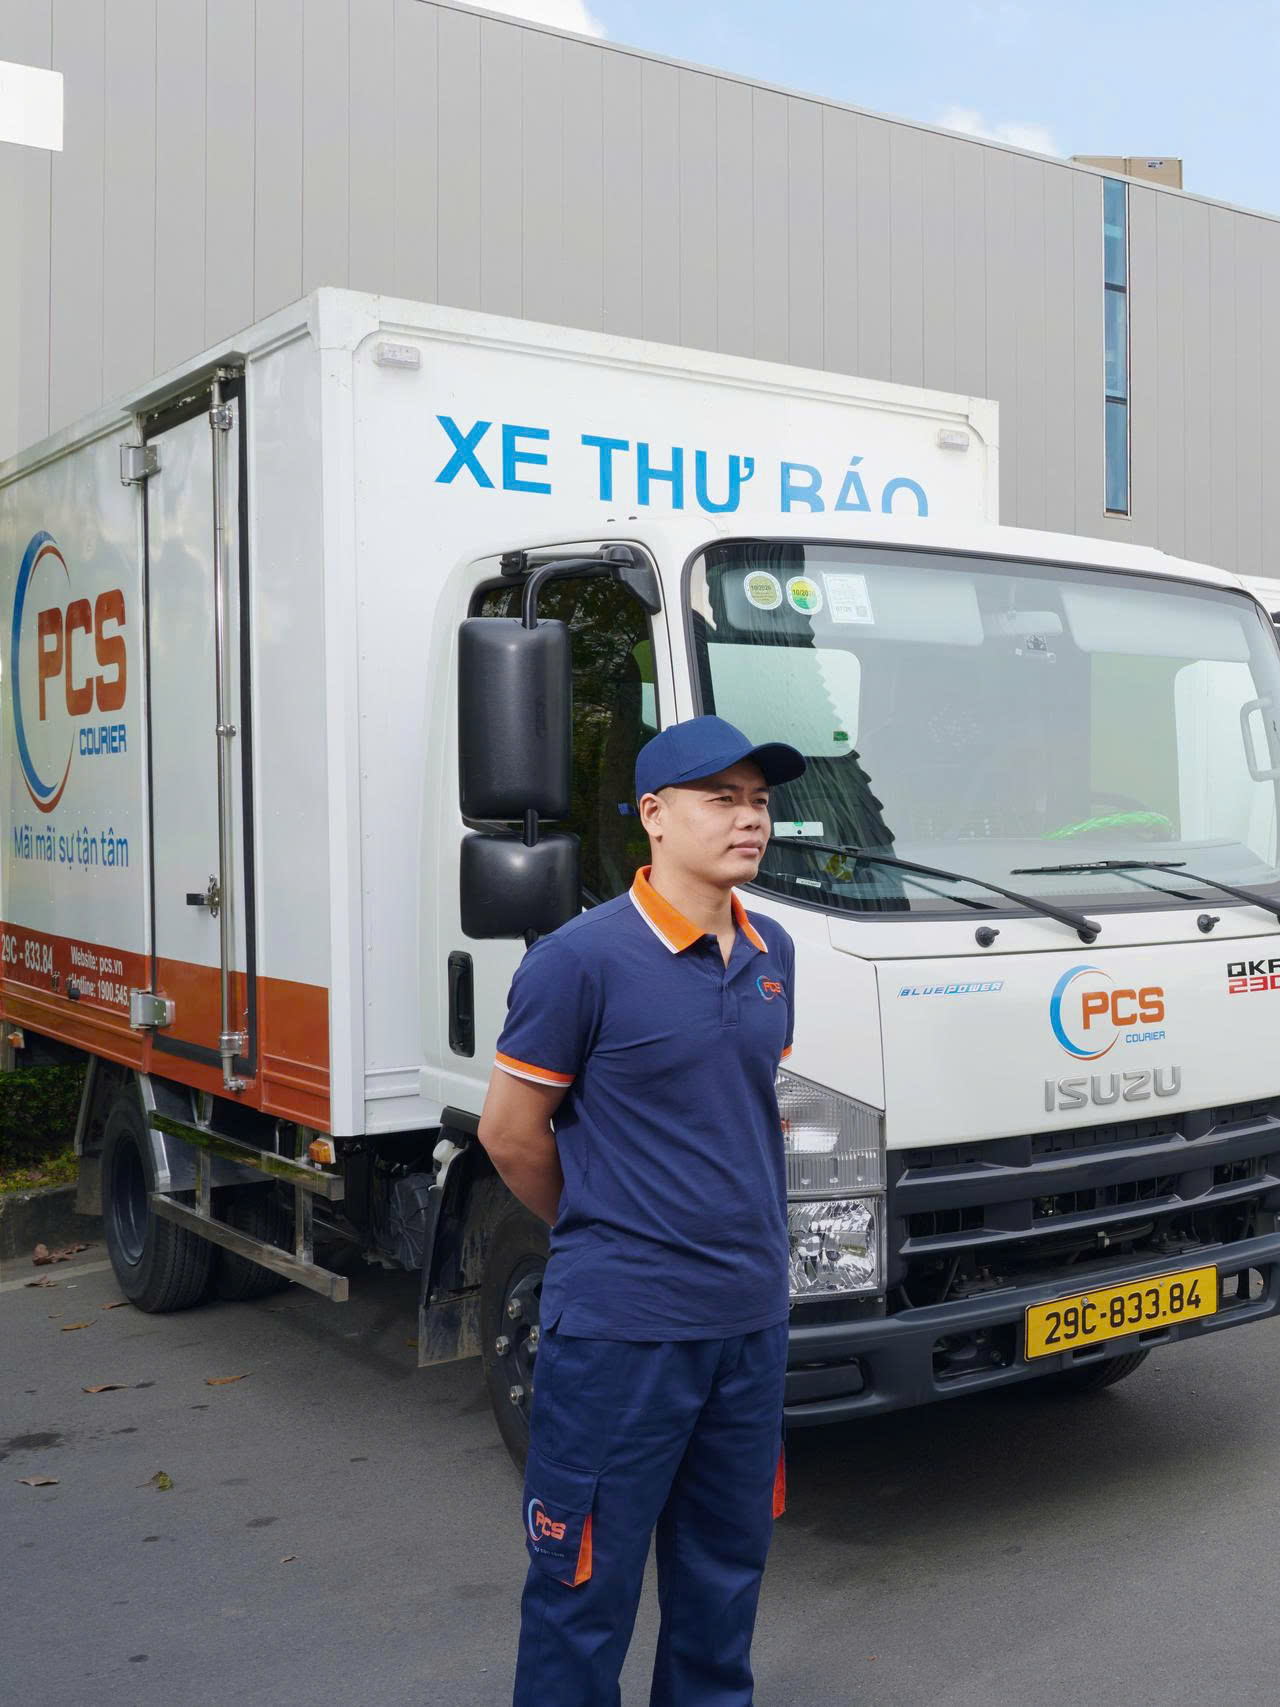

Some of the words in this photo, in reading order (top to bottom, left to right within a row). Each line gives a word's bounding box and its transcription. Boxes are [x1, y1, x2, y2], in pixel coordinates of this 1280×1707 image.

[435, 415, 552, 495] XE
[581, 434, 755, 513] THƯ
[780, 456, 929, 517] BÁO
[38, 588, 127, 721] PCS
[79, 724, 127, 756] COURIER
[14, 825, 33, 859] Mãi
[36, 826, 56, 862] mãi
[59, 834, 75, 870] sự
[76, 827, 98, 872] tận
[100, 828, 129, 868] tâm
[2, 933, 18, 964] 29C
[25, 940, 54, 975] 833.84
[70, 944, 98, 971] Website:
[99, 957, 124, 976] pcs.vn
[97, 979, 130, 1007] 1900.545.
[763, 982, 781, 993] PCS
[1082, 986, 1165, 1030] PCS
[1126, 1031, 1166, 1044] COURIER
[1044, 1065, 1182, 1112] ISUZU
[1044, 1279, 1201, 1345] 29C-833.84
[535, 1510, 566, 1541] PCS
